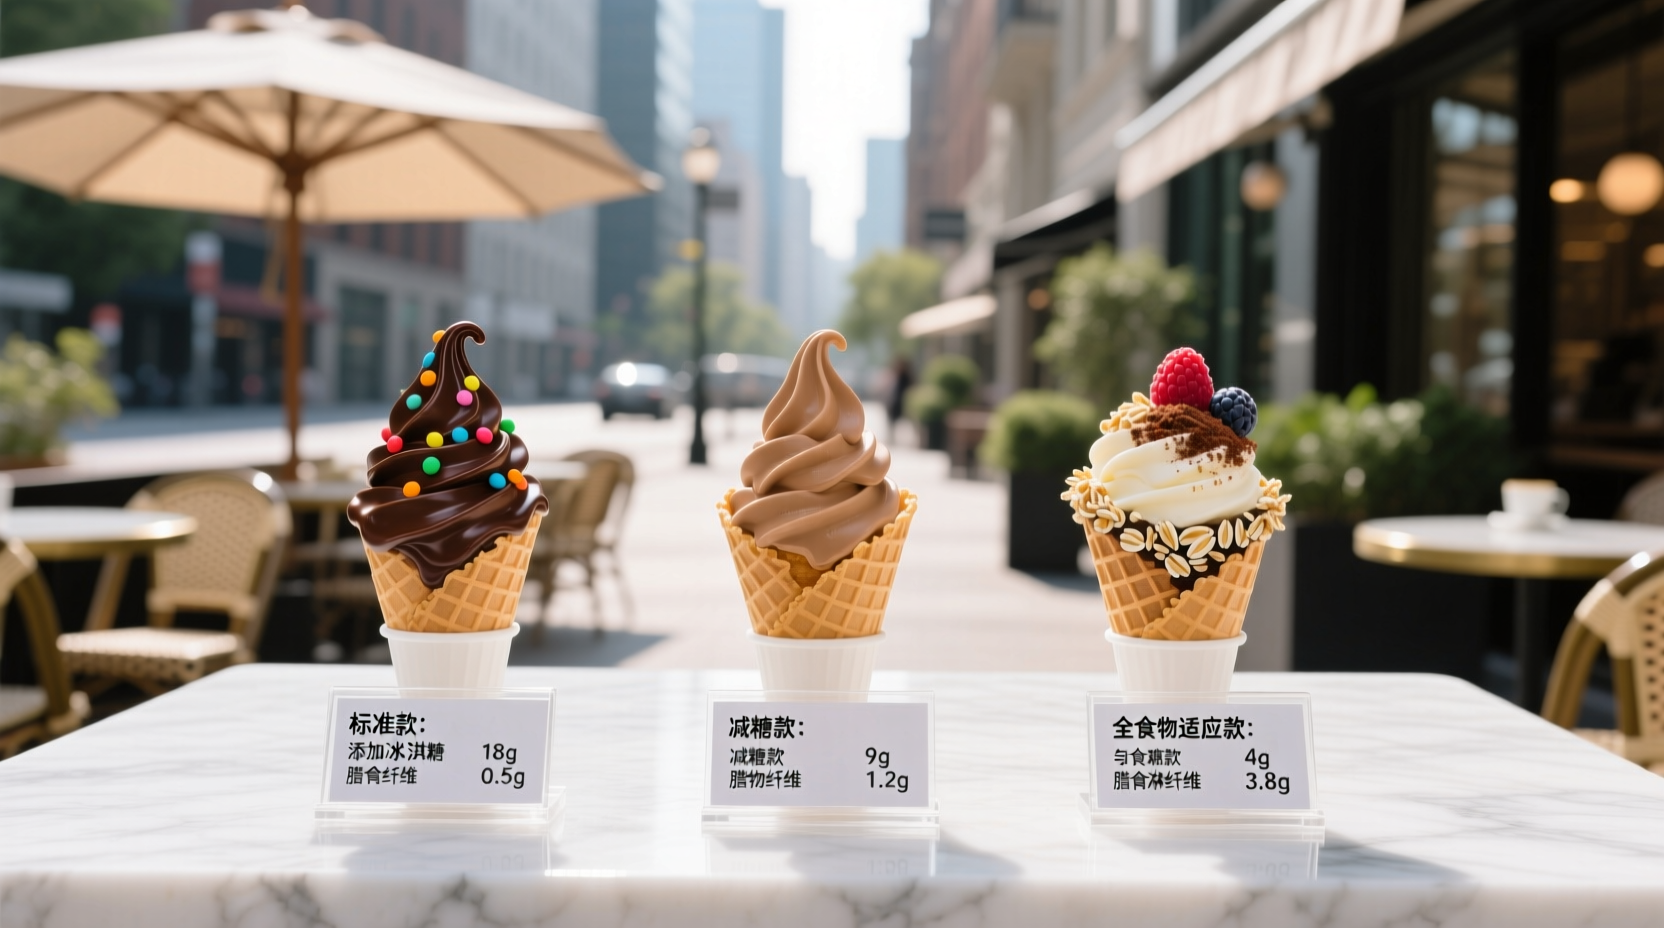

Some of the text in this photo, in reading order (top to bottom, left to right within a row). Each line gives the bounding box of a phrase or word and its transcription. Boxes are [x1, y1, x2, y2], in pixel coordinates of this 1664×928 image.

[482, 743, 517, 765] 18g
[865, 746, 890, 769] 9g
[1244, 747, 1270, 771] 4g
[481, 767, 525, 790] 0.5g
[866, 770, 909, 794] 1.2g
[1245, 771, 1290, 795] 3.8g
